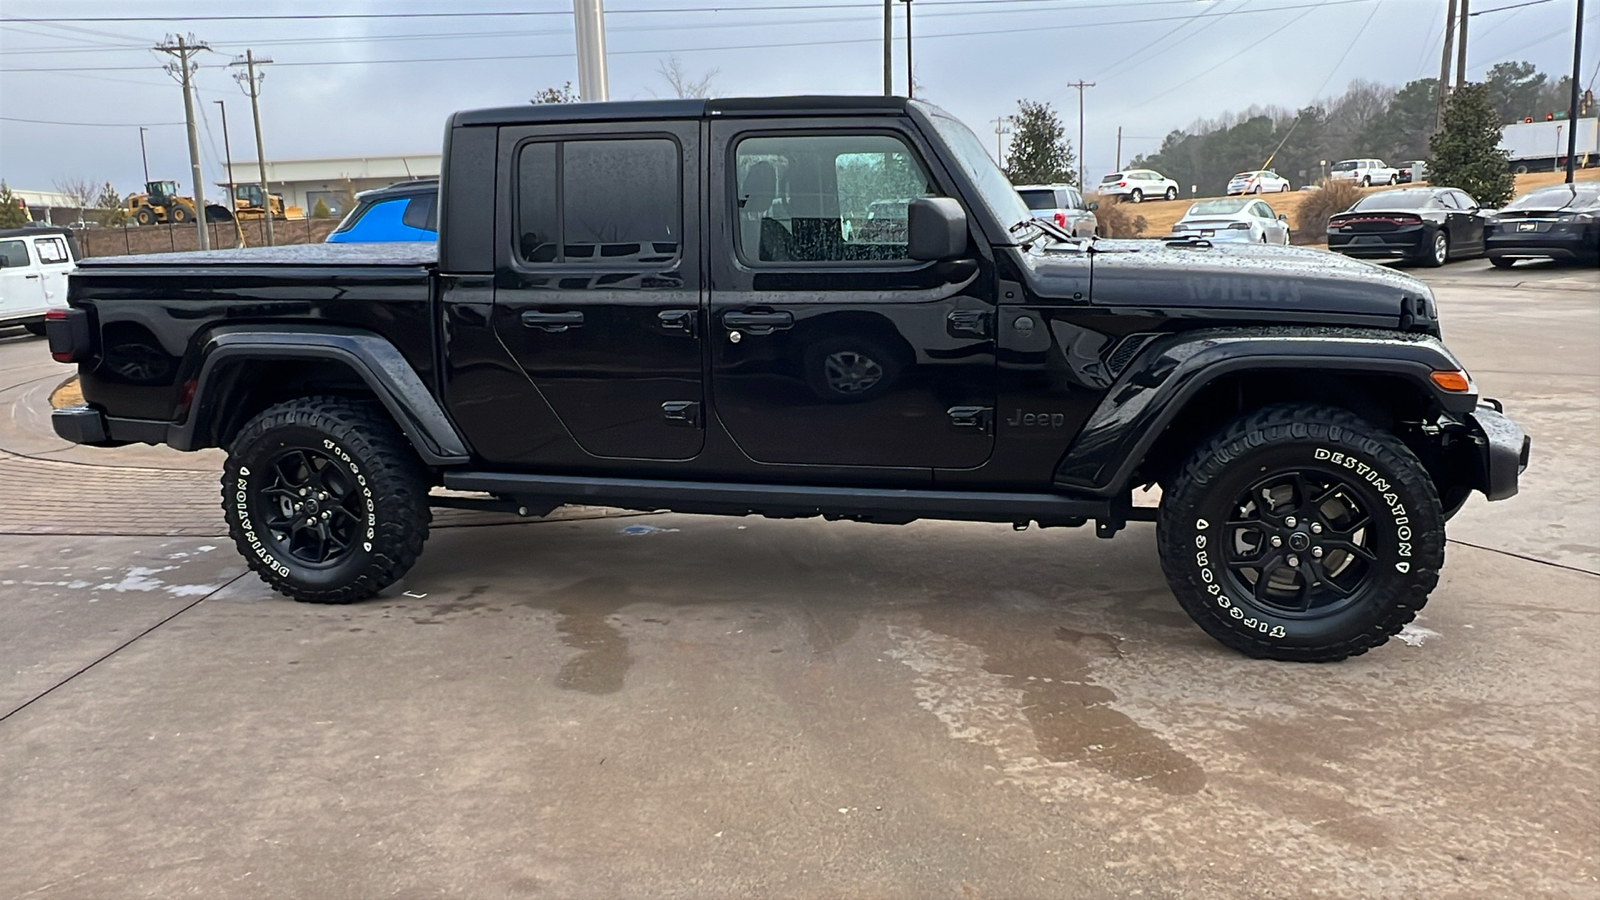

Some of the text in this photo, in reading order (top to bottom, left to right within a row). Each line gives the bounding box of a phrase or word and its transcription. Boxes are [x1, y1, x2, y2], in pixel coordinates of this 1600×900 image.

[1185, 276, 1305, 302] WILLYS
[1006, 408, 1065, 430] Jeep
[236, 478, 290, 578] DESTINATION
[1314, 448, 1412, 557] DESTINATION
